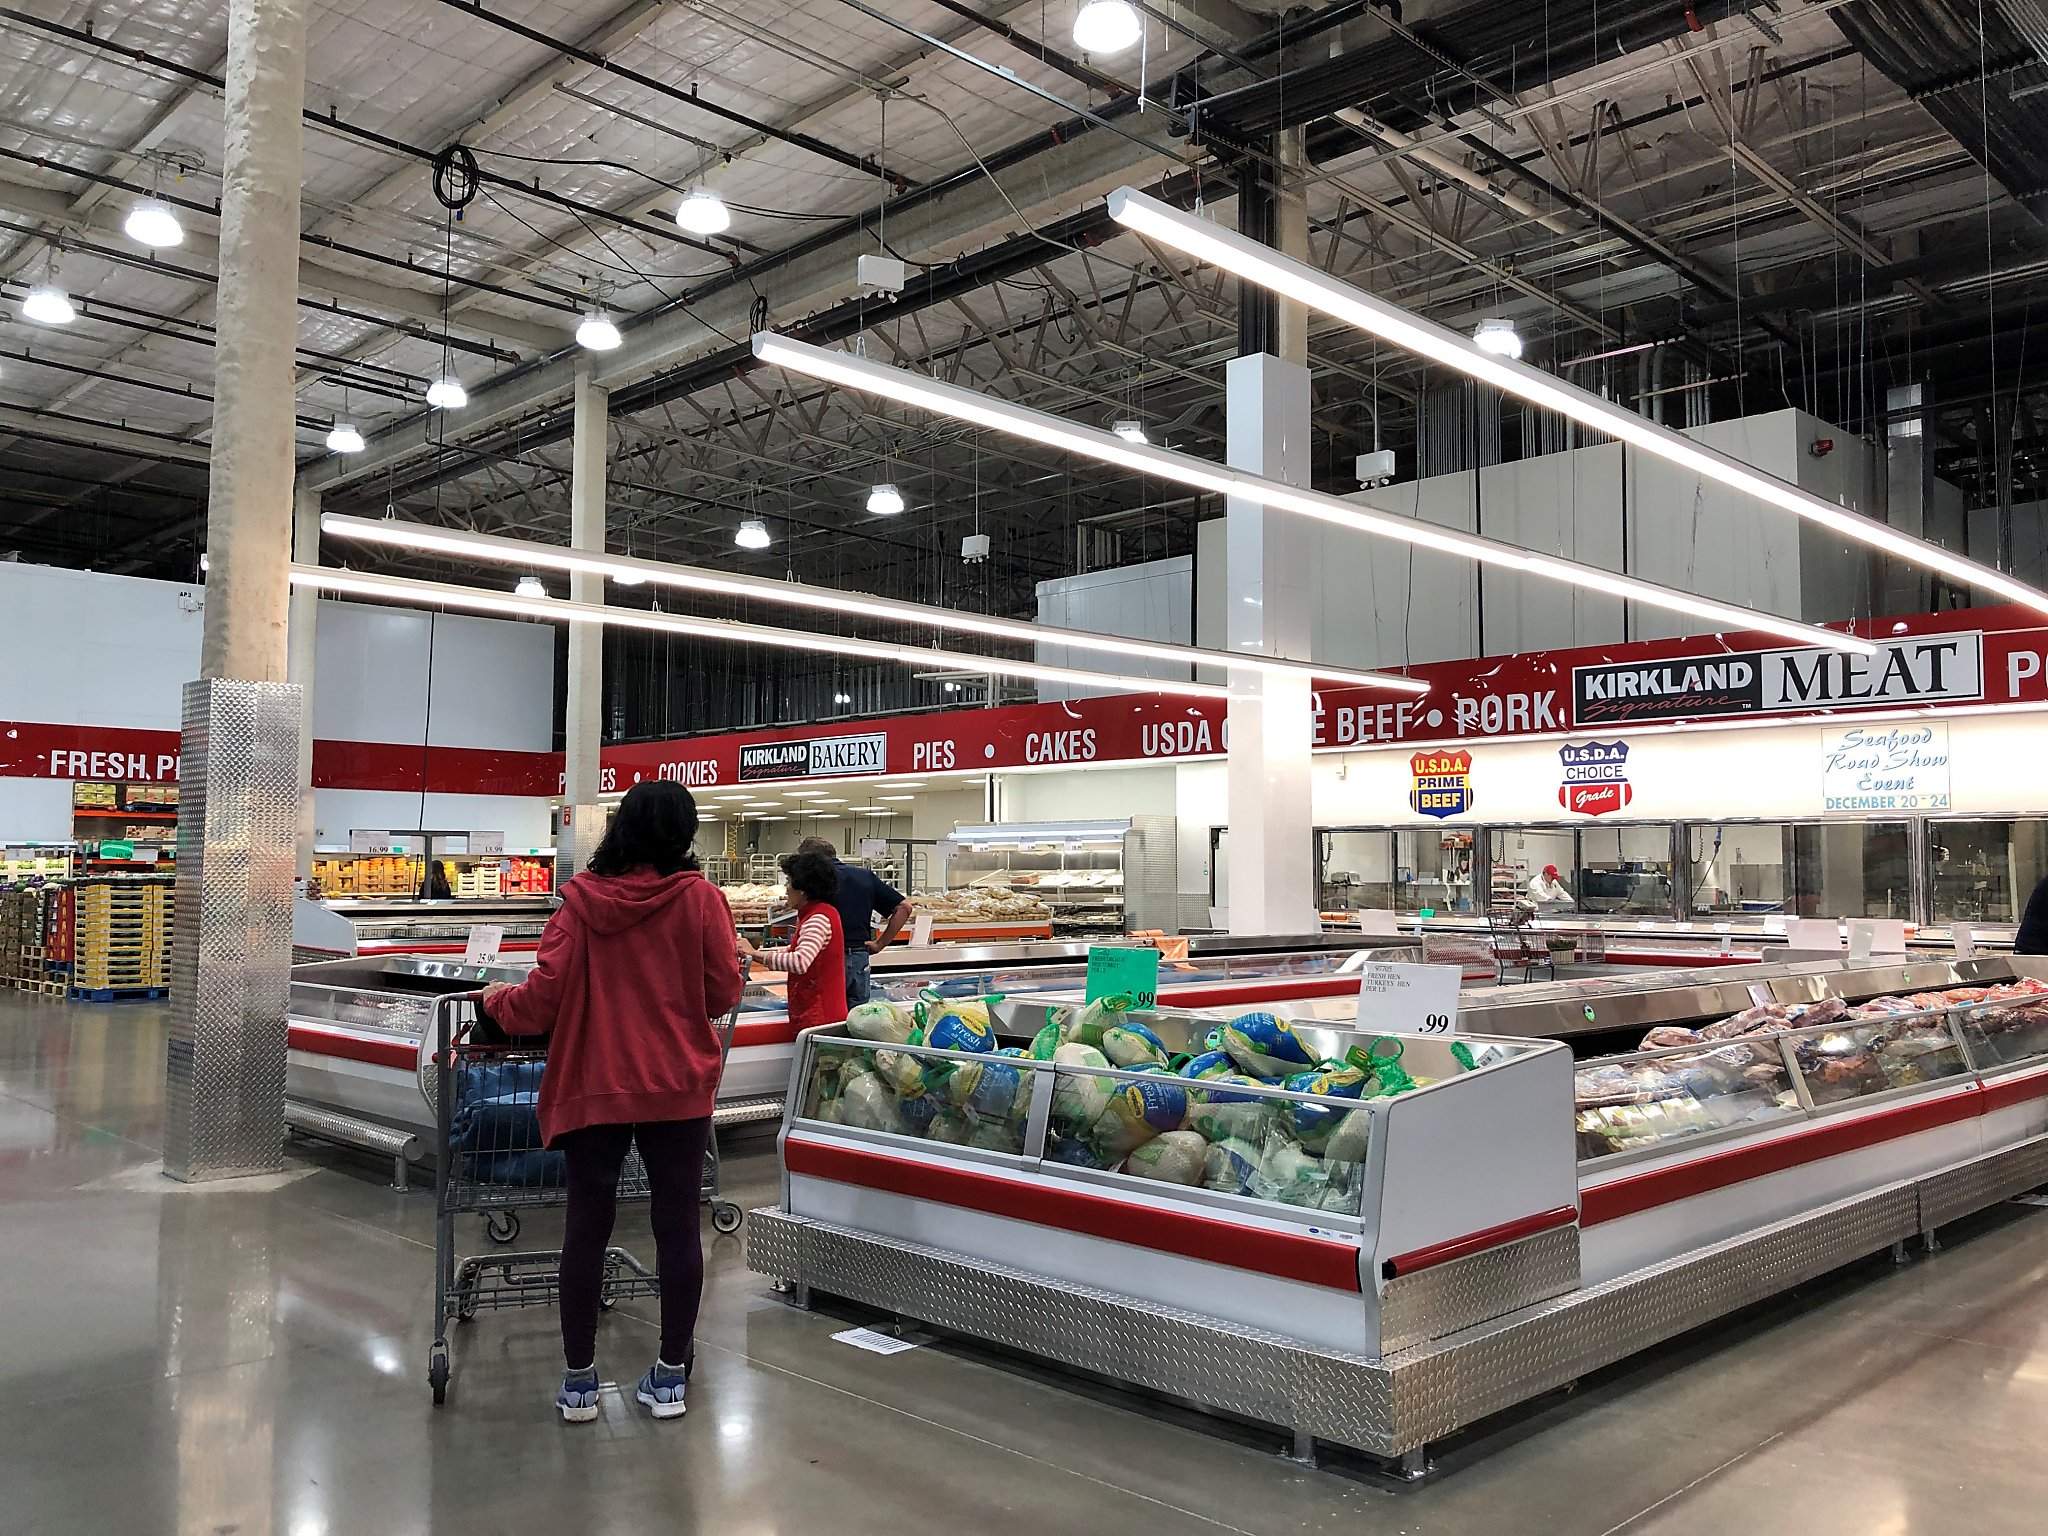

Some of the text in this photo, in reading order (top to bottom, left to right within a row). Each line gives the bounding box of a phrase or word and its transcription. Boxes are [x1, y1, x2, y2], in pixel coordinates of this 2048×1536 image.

[1585, 661, 1753, 700] KIRKLAND
[1778, 642, 1958, 703] MEAT
[2008, 650, 2048, 698] P
[1457, 690, 1557, 735] PORK
[1583, 694, 1752, 721] Signature
[1142, 719, 1212, 756] USDA
[1337, 702, 1413, 742] BEEF
[1838, 727, 1932, 753] Seafood
[743, 745, 807, 767] KIRKLAND
[811, 740, 882, 769] BAKERY
[913, 739, 955, 770] PIES
[1025, 728, 1097, 764] CAKES
[1564, 747, 1625, 763] U.S.D.A.
[50, 749, 181, 781] FRESH P
[658, 759, 718, 785] COOKIES
[742, 764, 803, 779] Signature
[1415, 758, 1467, 774] U.S.D.A.
[1566, 764, 1624, 780] CHOICE
[1825, 749, 1948, 773] Road Show
[1417, 776, 1465, 789] PRIME
[1856, 772, 1915, 791] Event
[1421, 792, 1461, 809] BEEF
[1575, 786, 1614, 808] Grade
[1826, 796, 1896, 810] DECEMBER
[1900, 795, 1918, 808] 20
[1930, 794, 1948, 807] 24
[476, 952, 496, 965] 25.99
[952, 1022, 981, 1047] Fresh
[1418, 1013, 1449, 1034] .99
